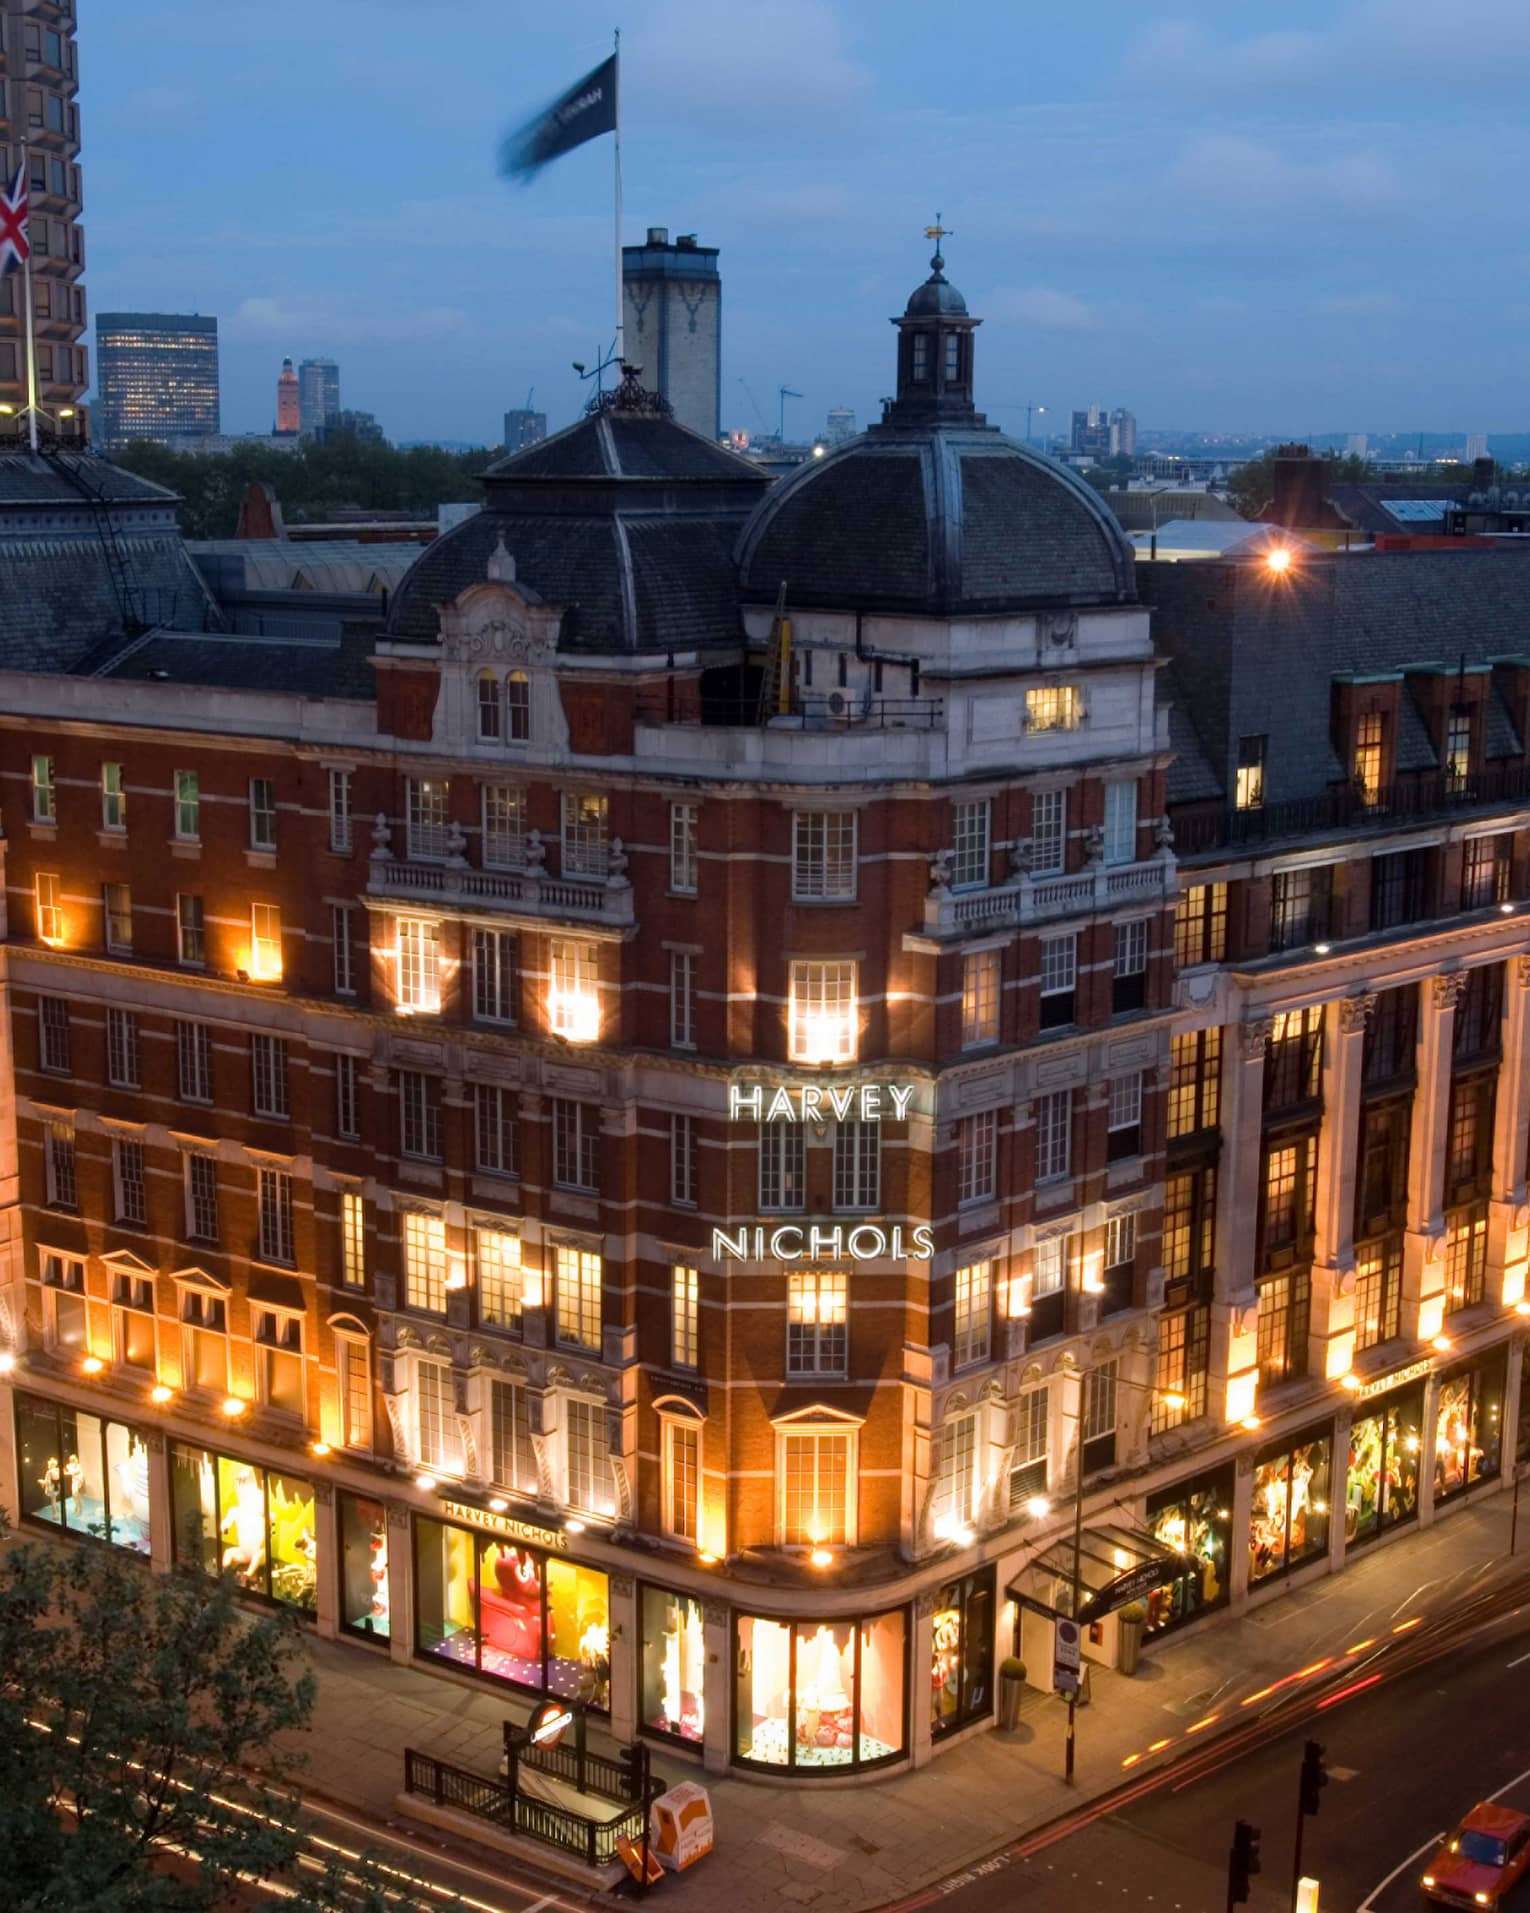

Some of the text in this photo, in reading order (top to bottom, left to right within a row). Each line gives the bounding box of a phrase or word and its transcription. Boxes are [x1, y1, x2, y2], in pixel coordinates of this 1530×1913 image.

[730, 1085, 914, 1122] HARVEY
[712, 1225, 935, 1263] NICHOLS
[445, 1501, 568, 1549] HARVEY NICHOLS
